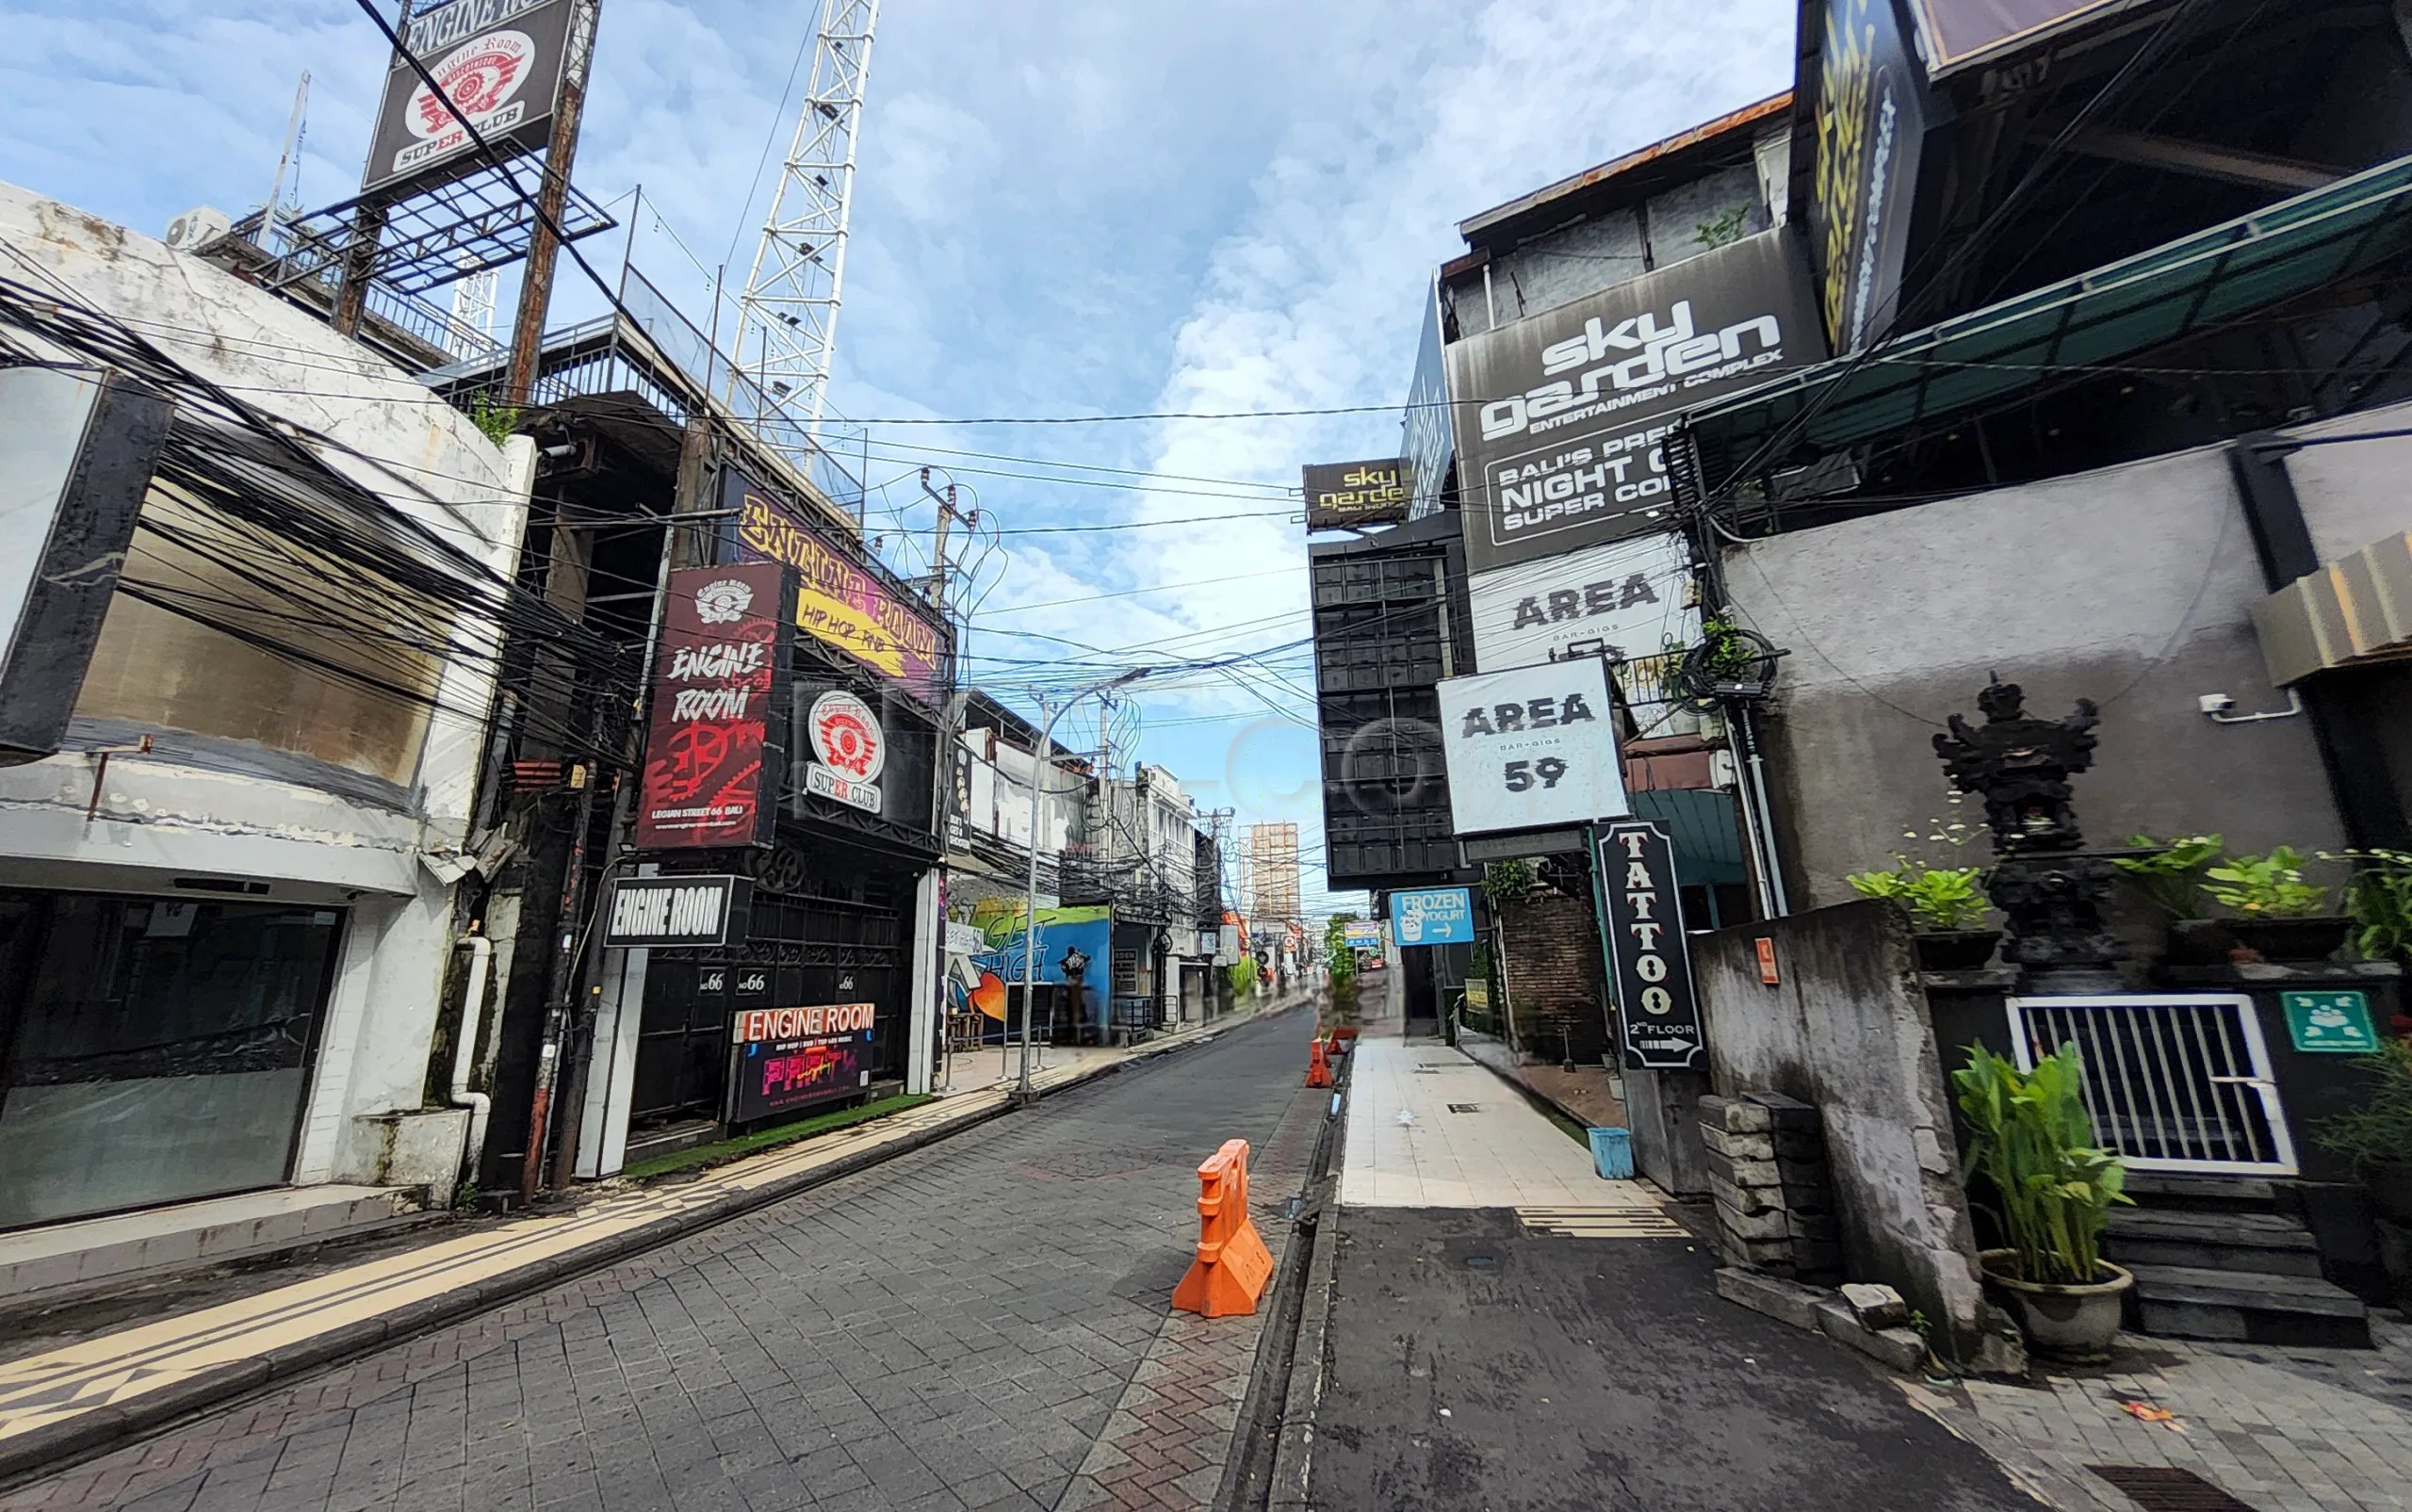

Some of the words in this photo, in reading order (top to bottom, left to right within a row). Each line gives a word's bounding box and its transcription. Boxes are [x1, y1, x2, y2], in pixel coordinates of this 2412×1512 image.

[408, 0, 497, 59] ENGINE
[484, 37, 522, 54] Room
[400, 130, 464, 166] SUPER
[1541, 301, 1695, 377] sky
[1480, 315, 1782, 441] garden
[1528, 380, 1679, 434] ENTERTAINMENT
[1684, 349, 1785, 387] COMPLEX
[1344, 466, 1396, 487] sky
[1498, 445, 1592, 486] BALI'S
[1501, 455, 1633, 512] NIGHT
[1504, 492, 1605, 530] SUPER
[739, 494, 866, 612] ENGINE
[872, 591, 937, 670] ROOM
[1510, 573, 1660, 631] AREA
[802, 603, 828, 628] HIP
[827, 614, 856, 641] HOP
[666, 641, 764, 682] ENGINE
[671, 686, 752, 723] ROOM
[1461, 692, 1596, 739] AREA
[813, 772, 849, 800] SUPER
[851, 786, 875, 807] CLUB
[1504, 756, 1568, 793] 59
[611, 888, 672, 936] ENGINE
[670, 886, 723, 936] ROOM
[1402, 892, 1465, 912] FROZEN
[1425, 909, 1466, 922] YOGURT
[984, 914, 1056, 951] GET
[1618, 832, 1672, 1015] TATTOO
[708, 973, 725, 991] 66
[747, 974, 765, 990] 66
[985, 945, 1048, 982] HIGH
[749, 1009, 823, 1042] ENGINE
[825, 1004, 874, 1033] ROOM
[1647, 1025, 1695, 1034] FLOOR
